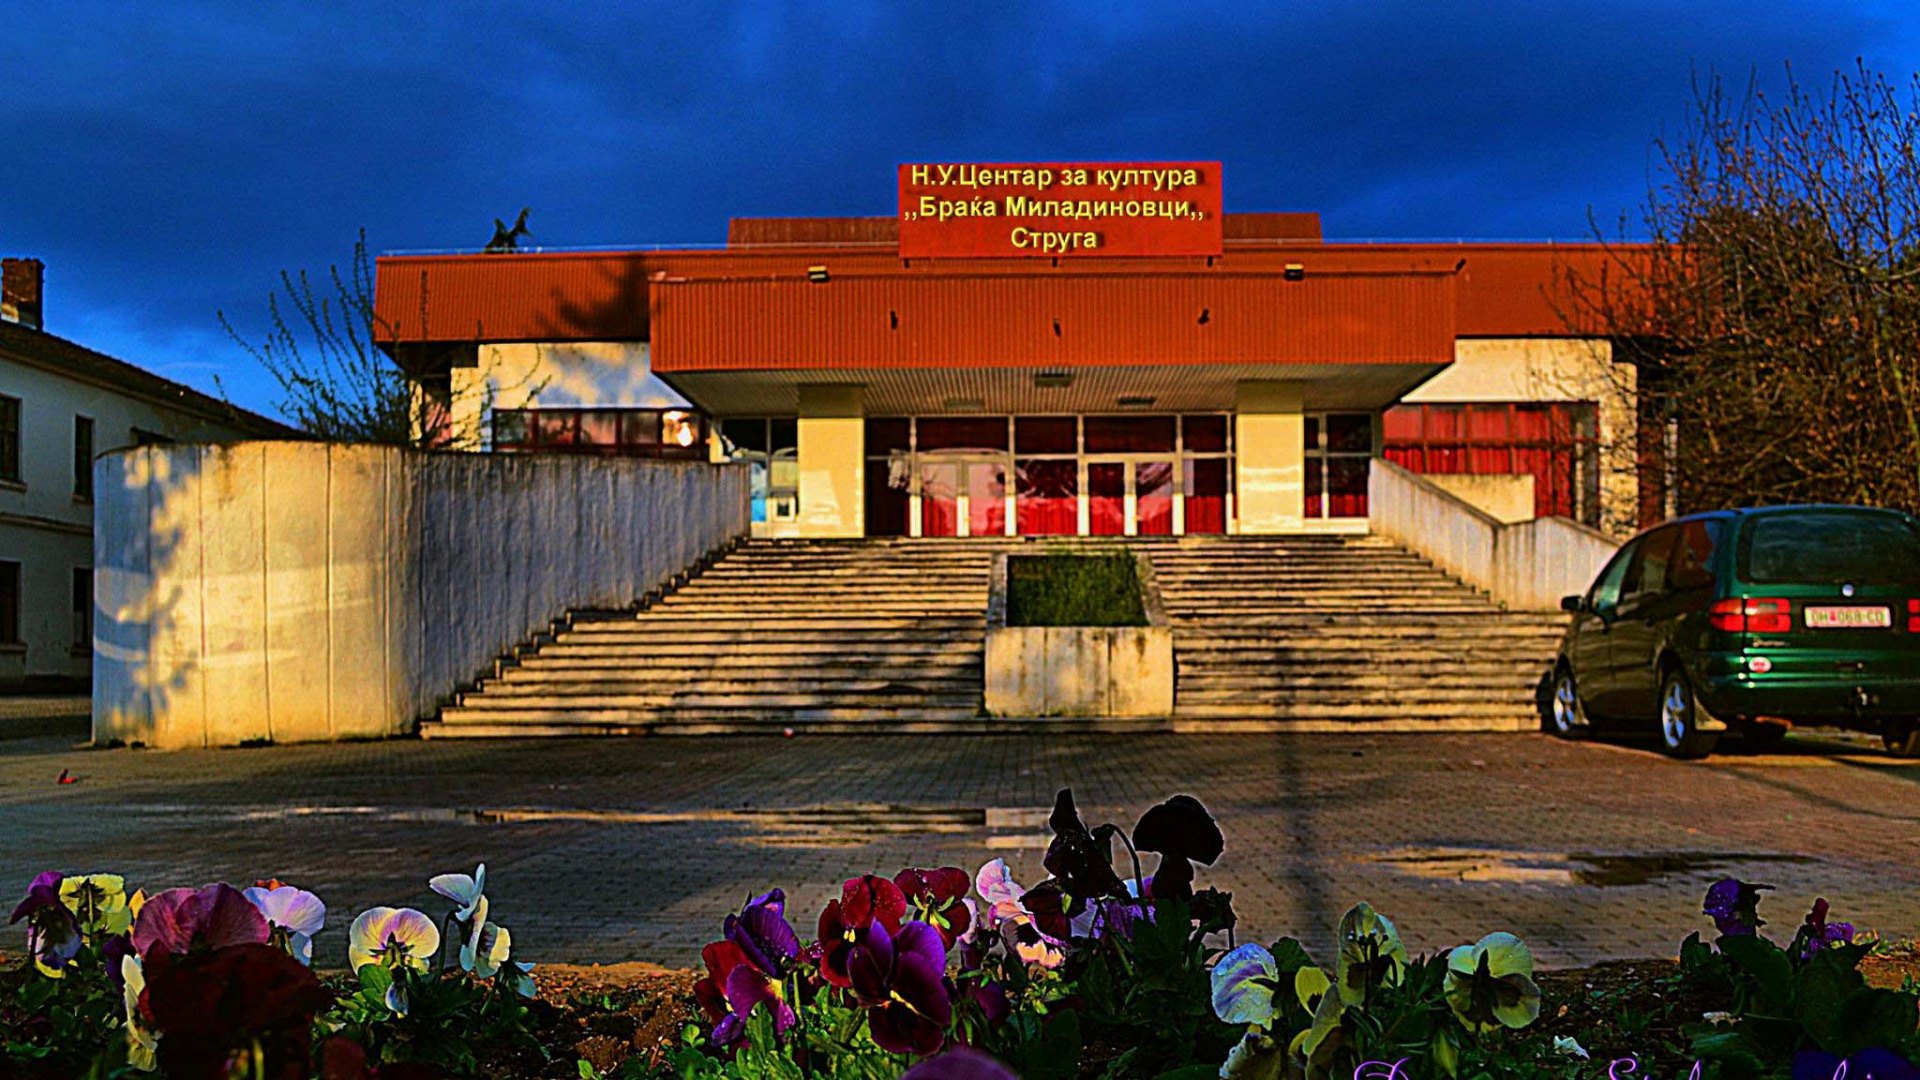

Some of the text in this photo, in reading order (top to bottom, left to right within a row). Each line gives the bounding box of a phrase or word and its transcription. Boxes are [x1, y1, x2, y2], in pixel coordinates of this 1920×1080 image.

[911, 164, 1198, 191] Н.У.Центар за култура
[1011, 226, 1098, 254] Струга
